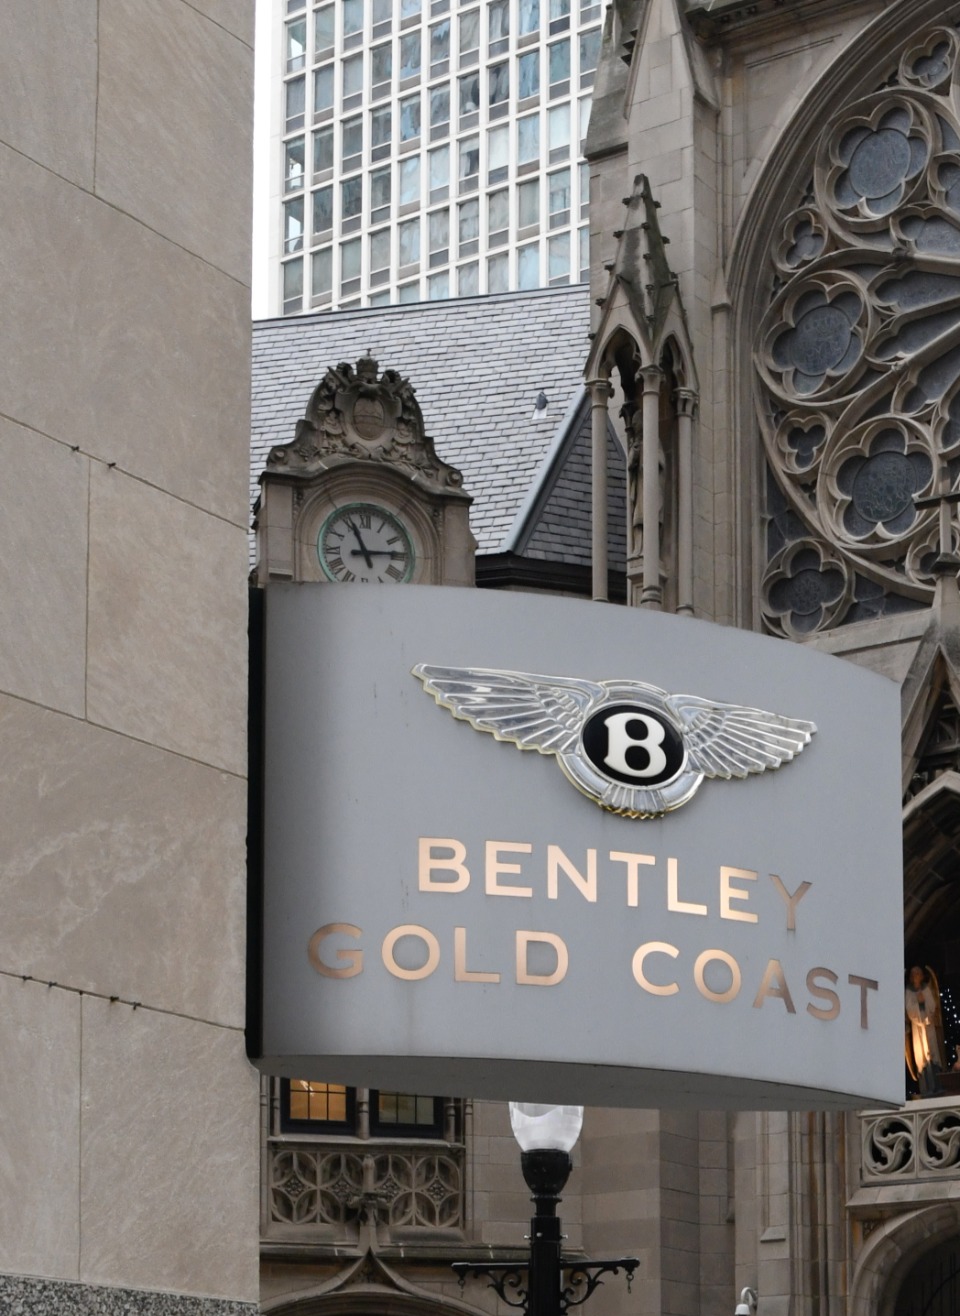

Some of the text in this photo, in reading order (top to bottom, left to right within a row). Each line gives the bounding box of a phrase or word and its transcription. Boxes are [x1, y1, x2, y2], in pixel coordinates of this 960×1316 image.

[603, 711, 668, 777] B
[417, 836, 813, 931] BENTLEY
[307, 922, 879, 1029] GOLD COAST
